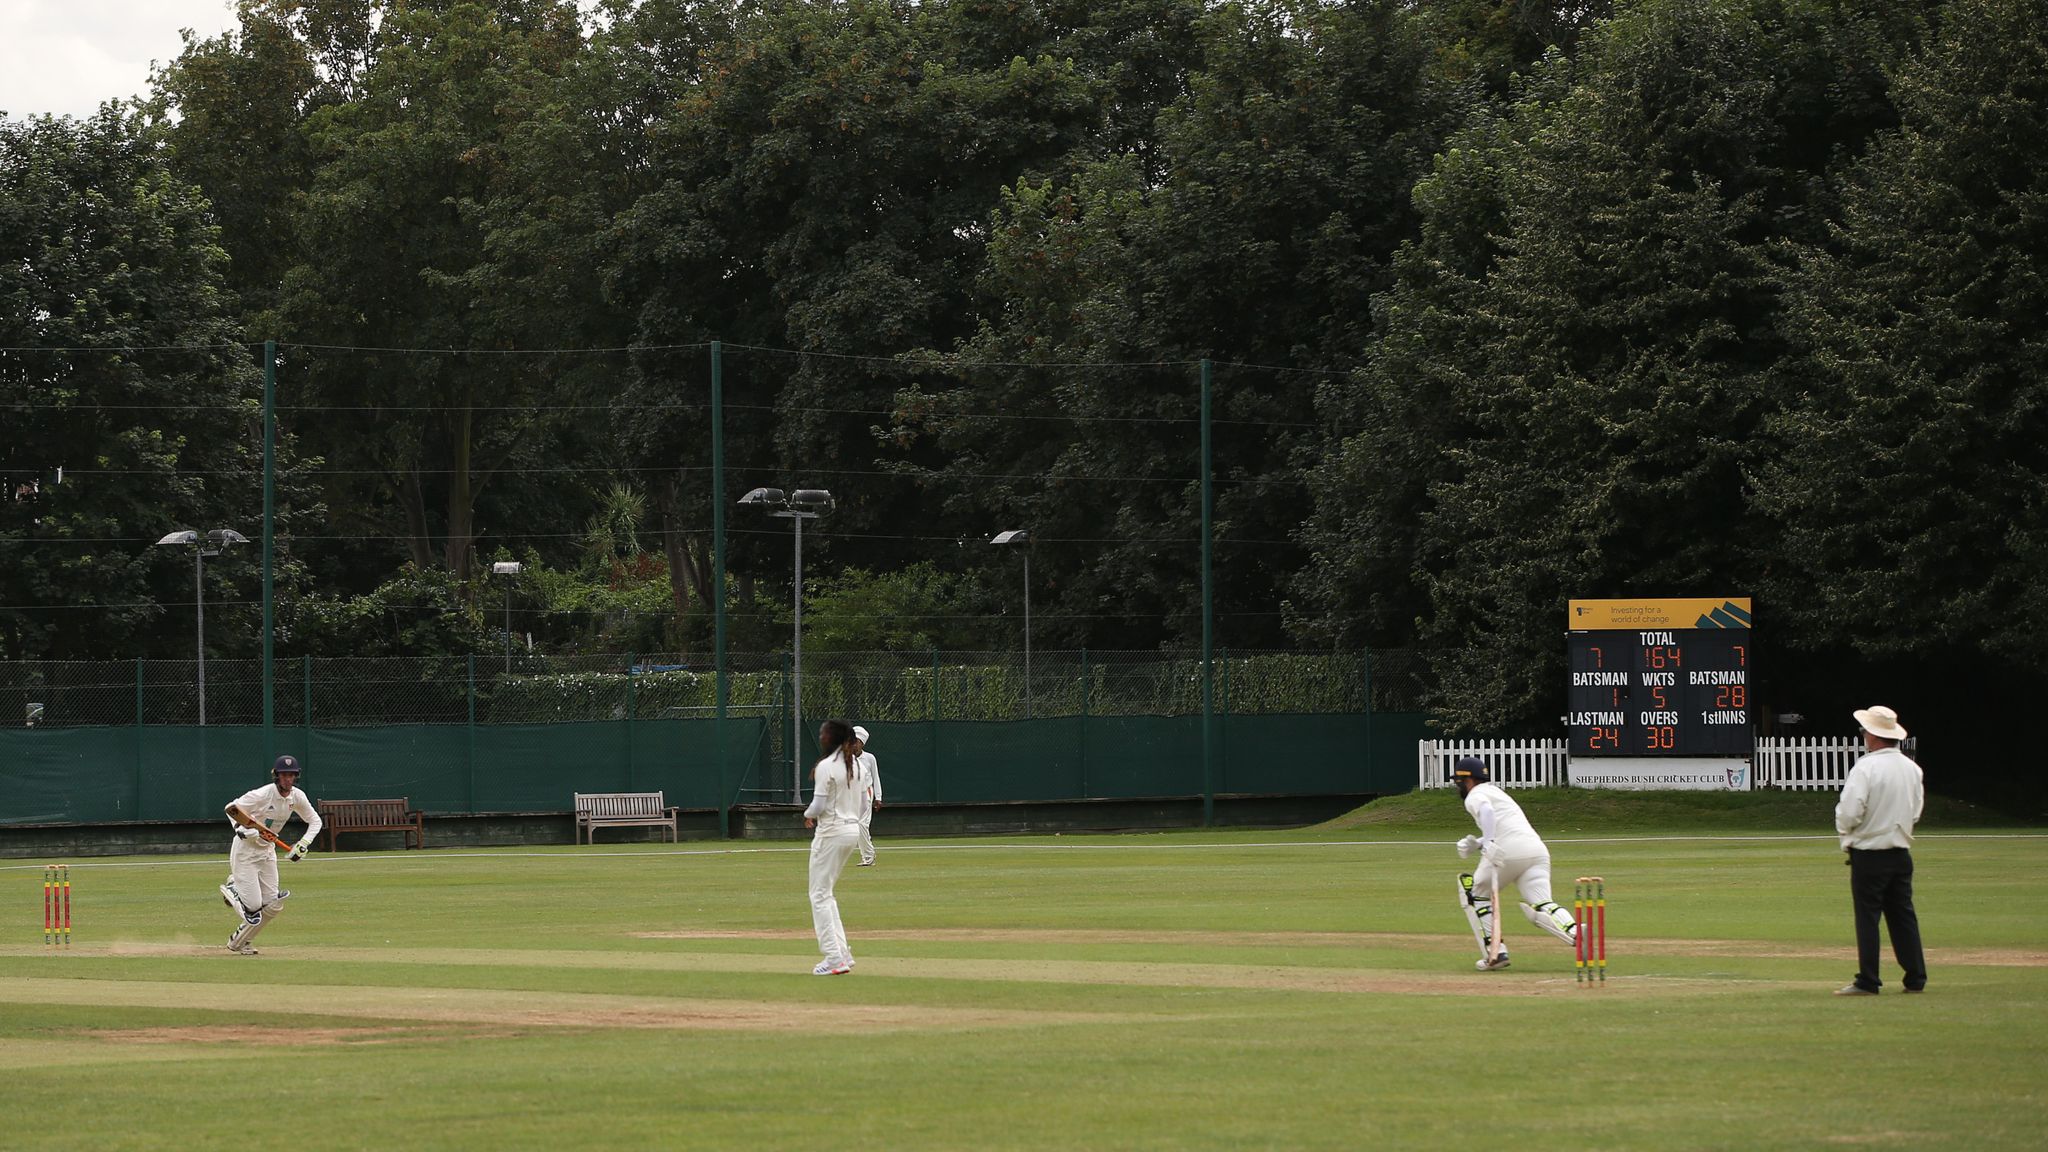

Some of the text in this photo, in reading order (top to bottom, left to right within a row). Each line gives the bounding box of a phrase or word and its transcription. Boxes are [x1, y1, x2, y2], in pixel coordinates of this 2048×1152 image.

[1611, 606, 1643, 615] Investing
[1644, 606, 1655, 614] for
[1633, 615, 1641, 623] of
[1642, 615, 1670, 624] change
[1640, 631, 1676, 646] TOTAL
[1590, 647, 1602, 668] 7
[1645, 646, 1681, 669] 164
[1732, 646, 1745, 667] 7
[1573, 672, 1628, 686] BATSMAN
[1642, 672, 1675, 686] WKTS
[1689, 670, 1745, 685] BATSMAN
[1613, 688, 1618, 708] 1
[1652, 686, 1666, 709] 5
[1716, 685, 1745, 708] 28
[1570, 711, 1624, 726] LASTMAN
[1640, 711, 1679, 726] OVERS
[1701, 710, 1746, 725] 1stINNS
[1589, 727, 1619, 749] 24
[1647, 726, 1674, 749] 30
[1576, 774, 1725, 784] SHEPHERDS BUSH CRICKET CLUB
